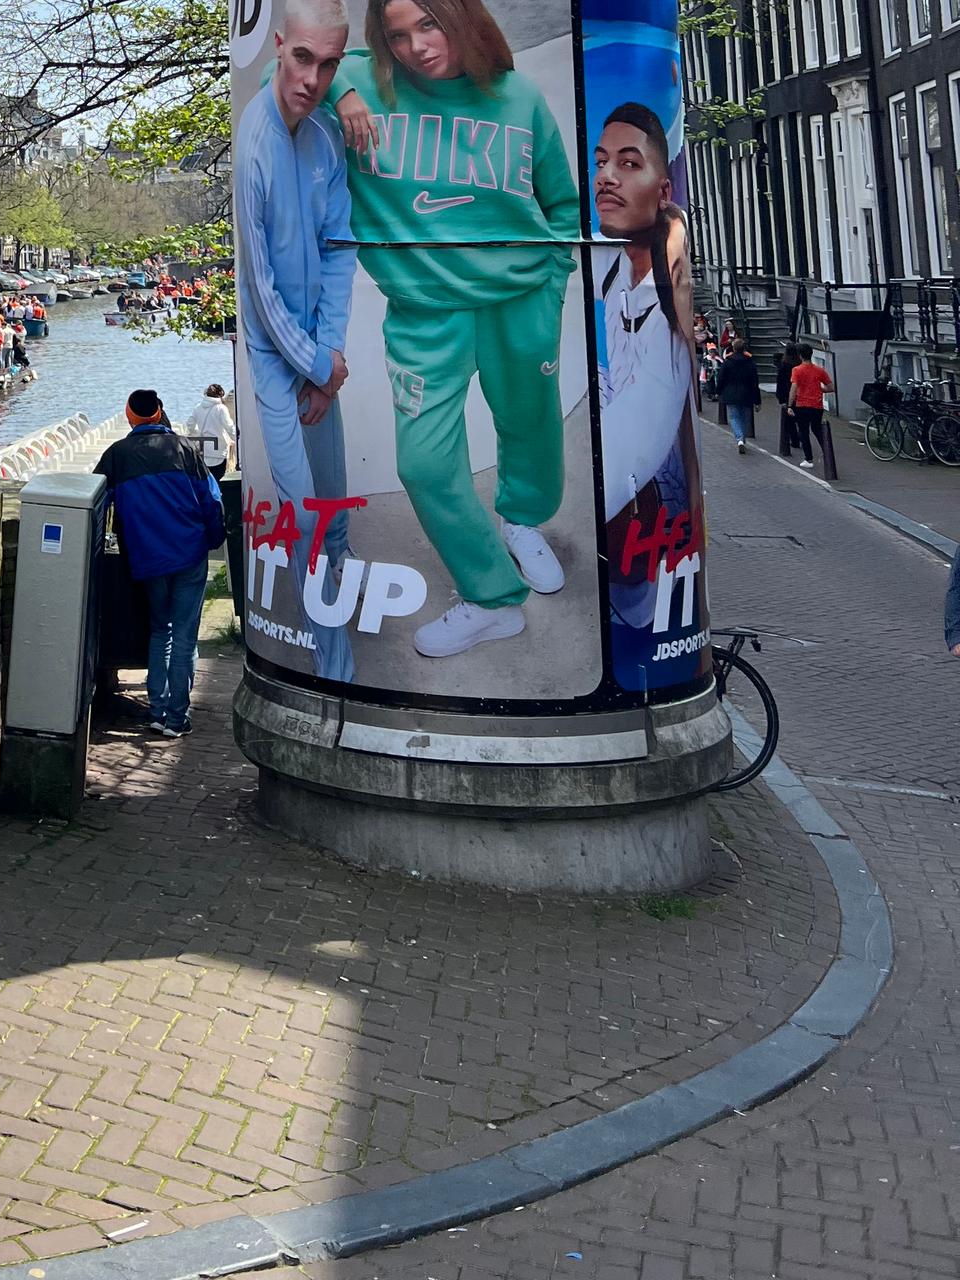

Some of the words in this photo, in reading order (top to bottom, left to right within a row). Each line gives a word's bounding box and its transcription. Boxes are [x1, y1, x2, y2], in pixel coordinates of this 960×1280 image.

[357, 114, 534, 199] NIKE
[248, 536, 289, 611] IT
[303, 554, 428, 634] UP
[652, 552, 700, 634] IT
